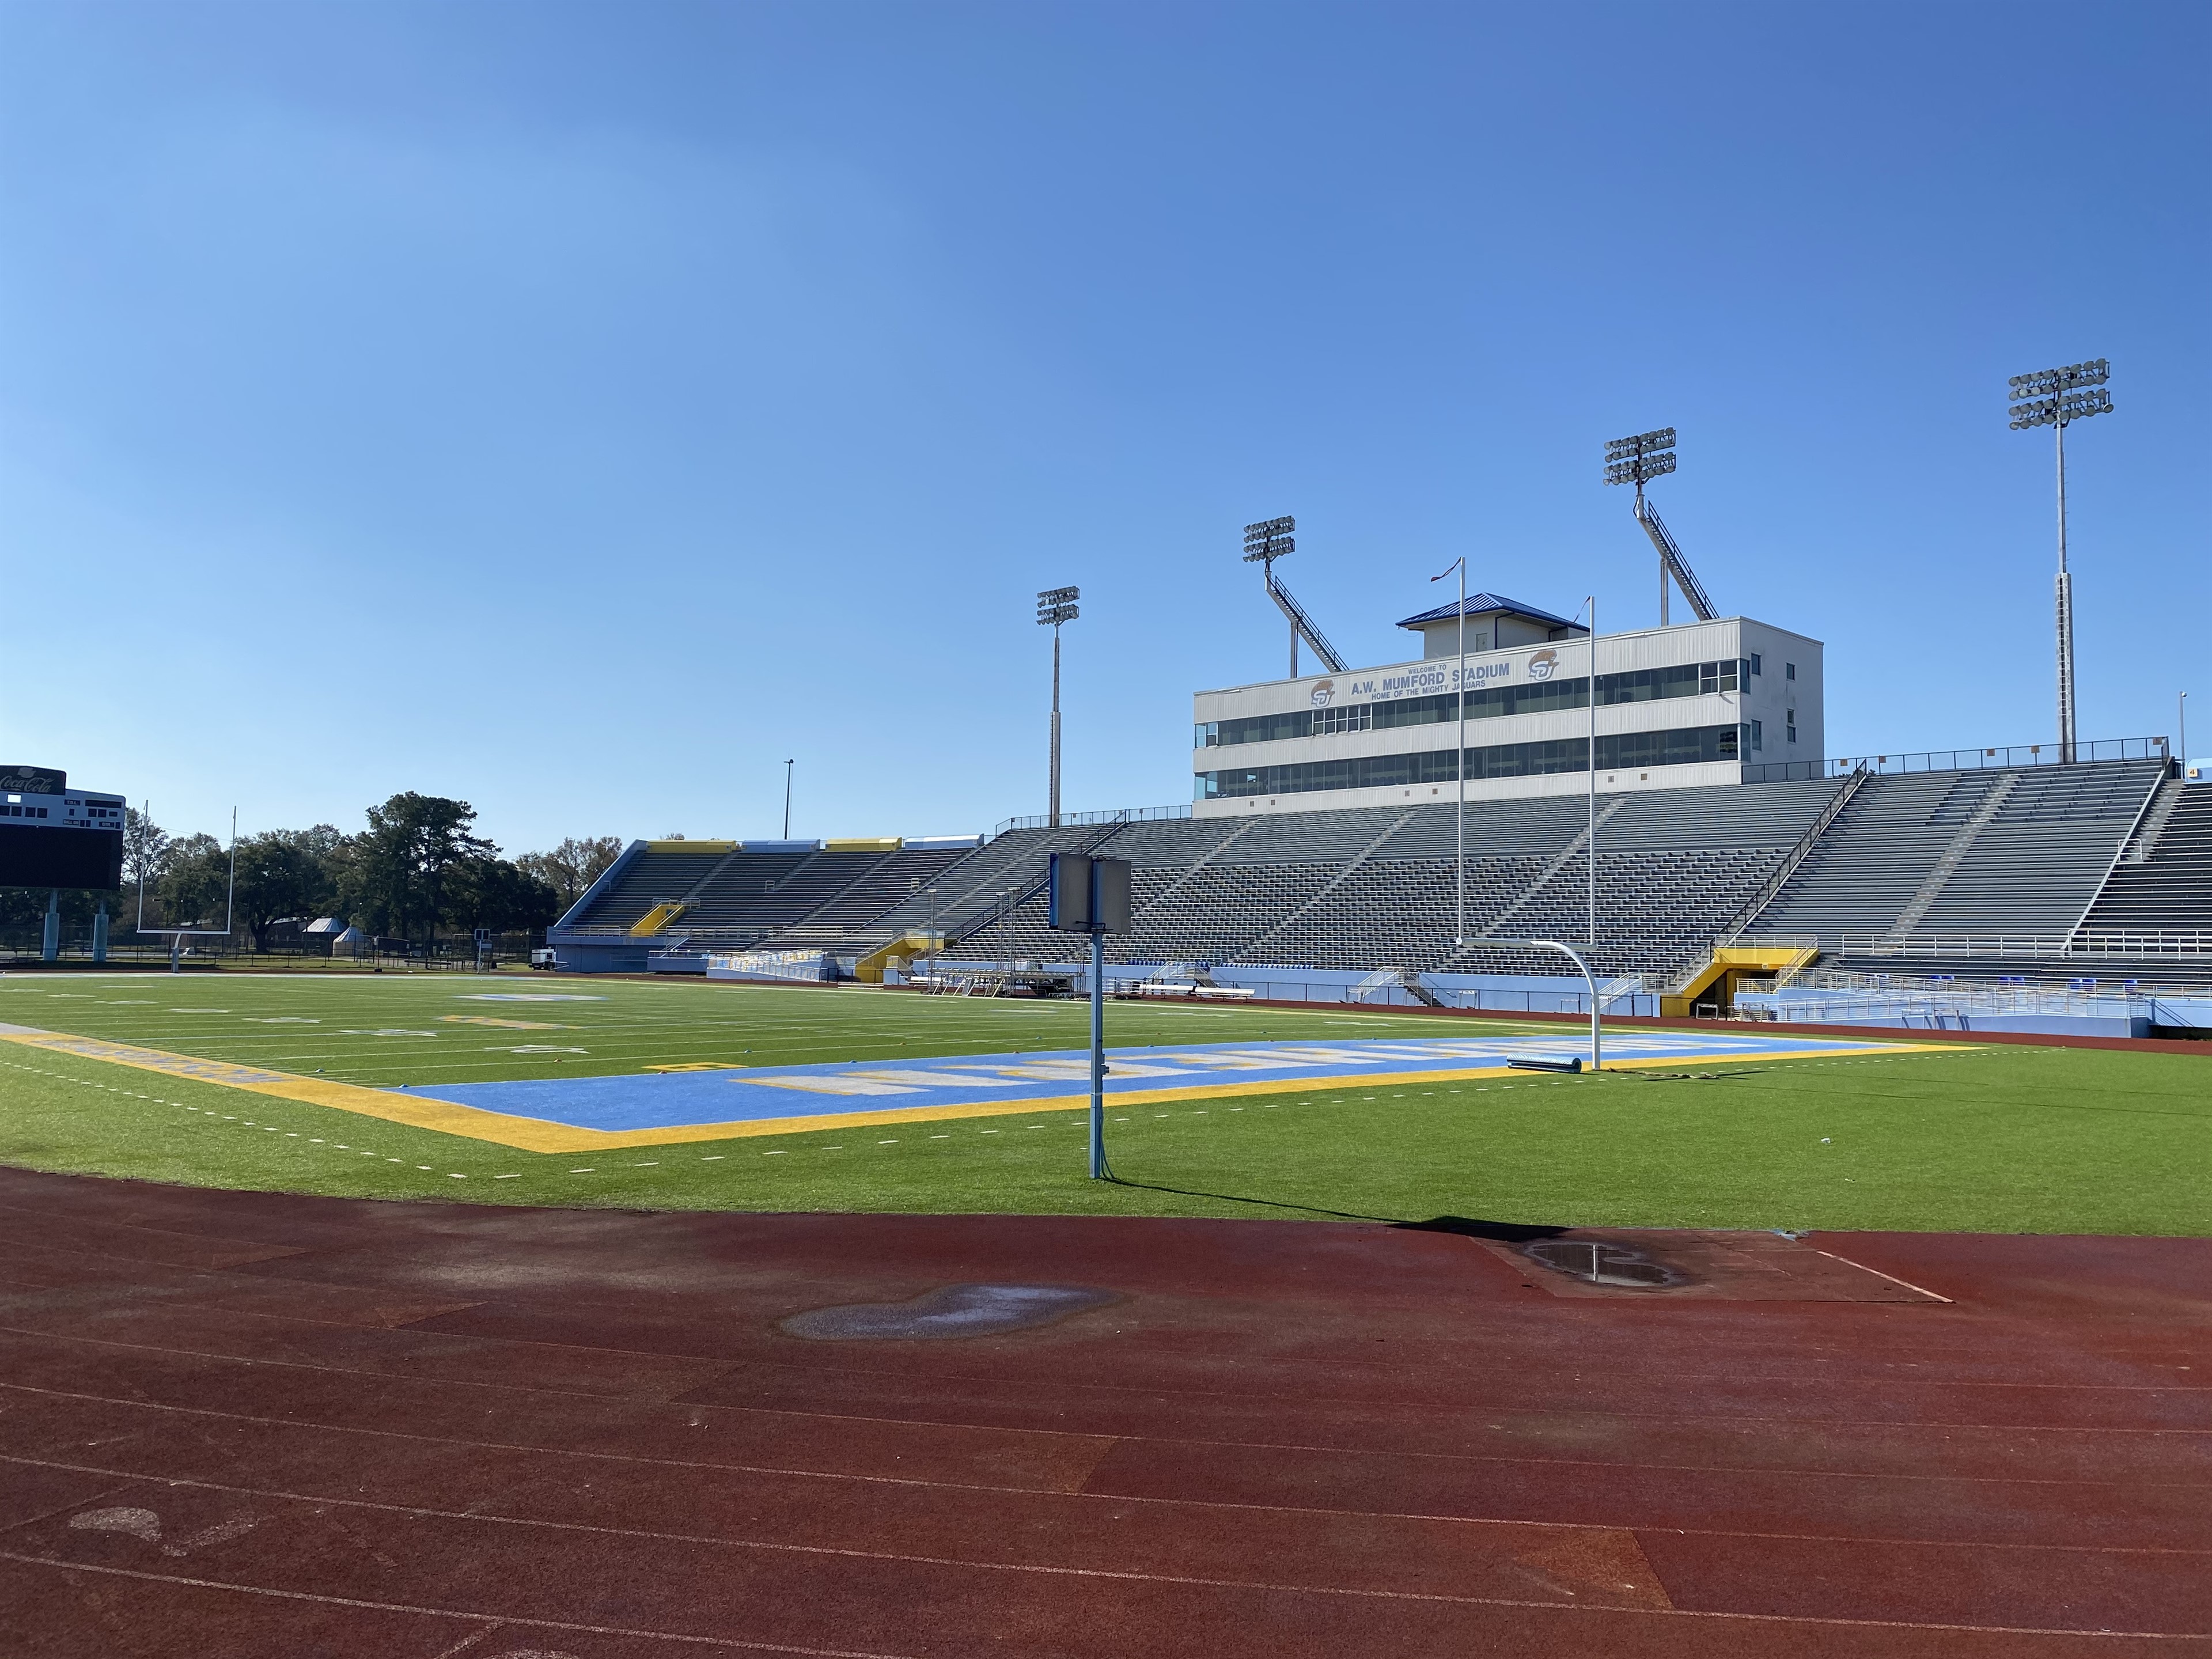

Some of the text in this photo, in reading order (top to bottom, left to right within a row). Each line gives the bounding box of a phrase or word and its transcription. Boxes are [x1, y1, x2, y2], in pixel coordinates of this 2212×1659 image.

[1408, 665, 1436, 675] WELCOME
[1351, 681, 1376, 695] A.W.
[1383, 672, 1445, 691] MUMFORD
[1372, 691, 1391, 700] HOME
[1422, 684, 1449, 694] MIGHTY
[1452, 680, 1486, 691] JAUARS
